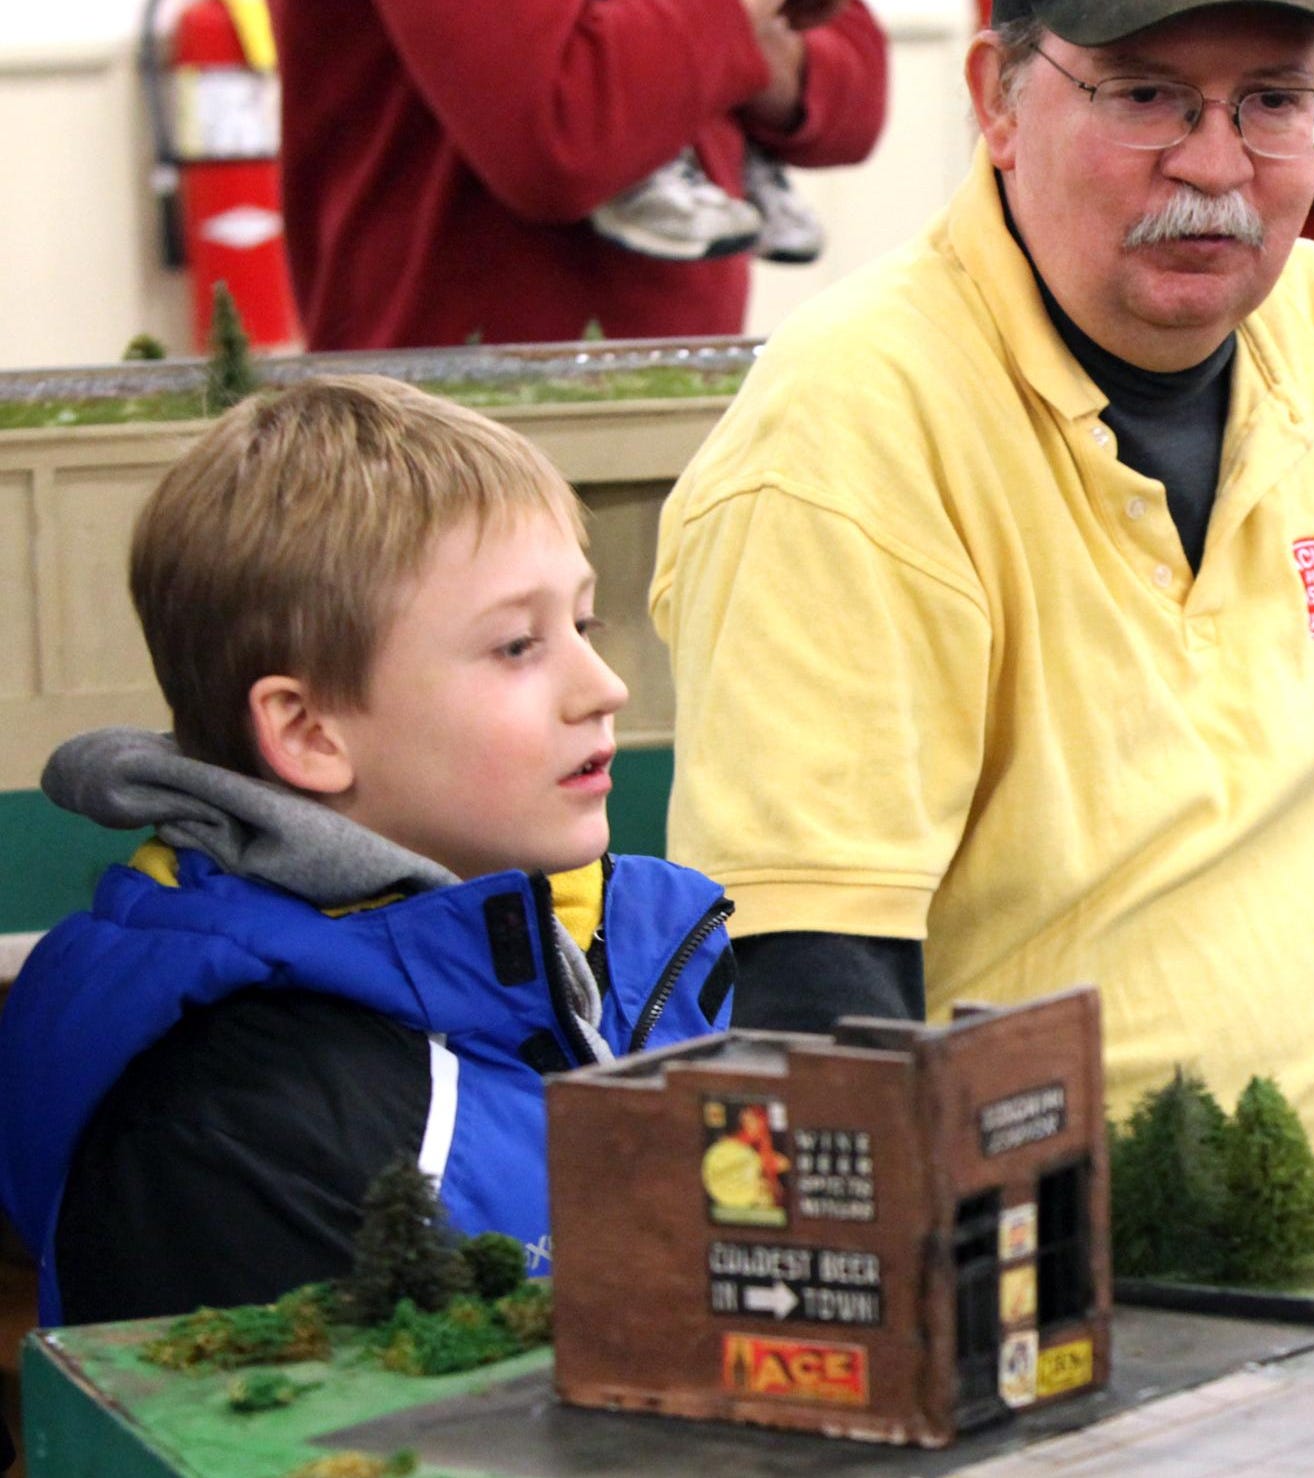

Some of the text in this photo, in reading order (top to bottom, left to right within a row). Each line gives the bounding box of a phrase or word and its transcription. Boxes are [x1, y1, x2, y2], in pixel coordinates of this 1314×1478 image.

[709, 1242, 881, 1285] COLDEST BEER
[711, 1280, 739, 1313] IN
[755, 1350, 855, 1393] ACE
